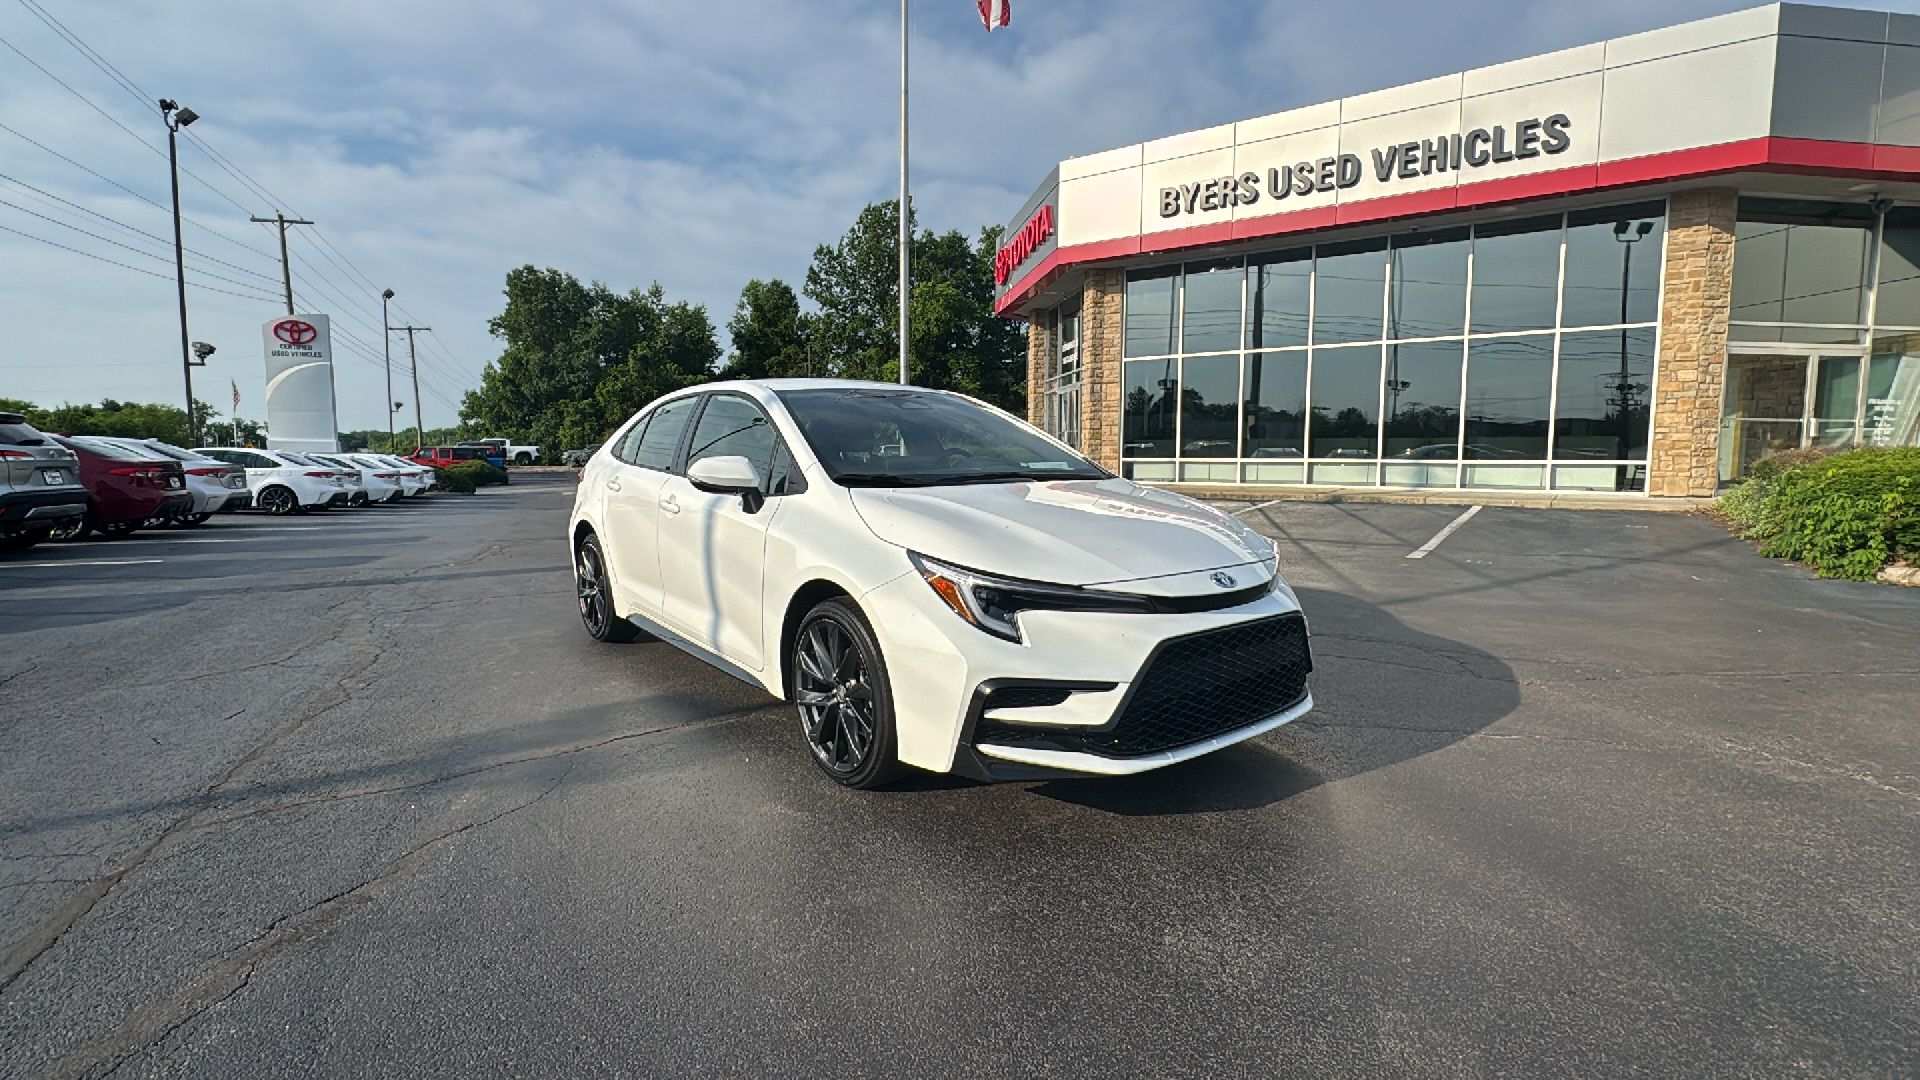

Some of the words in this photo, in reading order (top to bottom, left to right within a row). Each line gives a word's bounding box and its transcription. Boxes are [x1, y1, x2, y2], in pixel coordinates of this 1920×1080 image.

[1160, 171, 1260, 218] BYERS
[1268, 153, 1362, 200] USED
[1371, 113, 1571, 182] VEHICLES
[1008, 205, 1053, 270] TOYOTA
[279, 343, 313, 351] CERTIFIED
